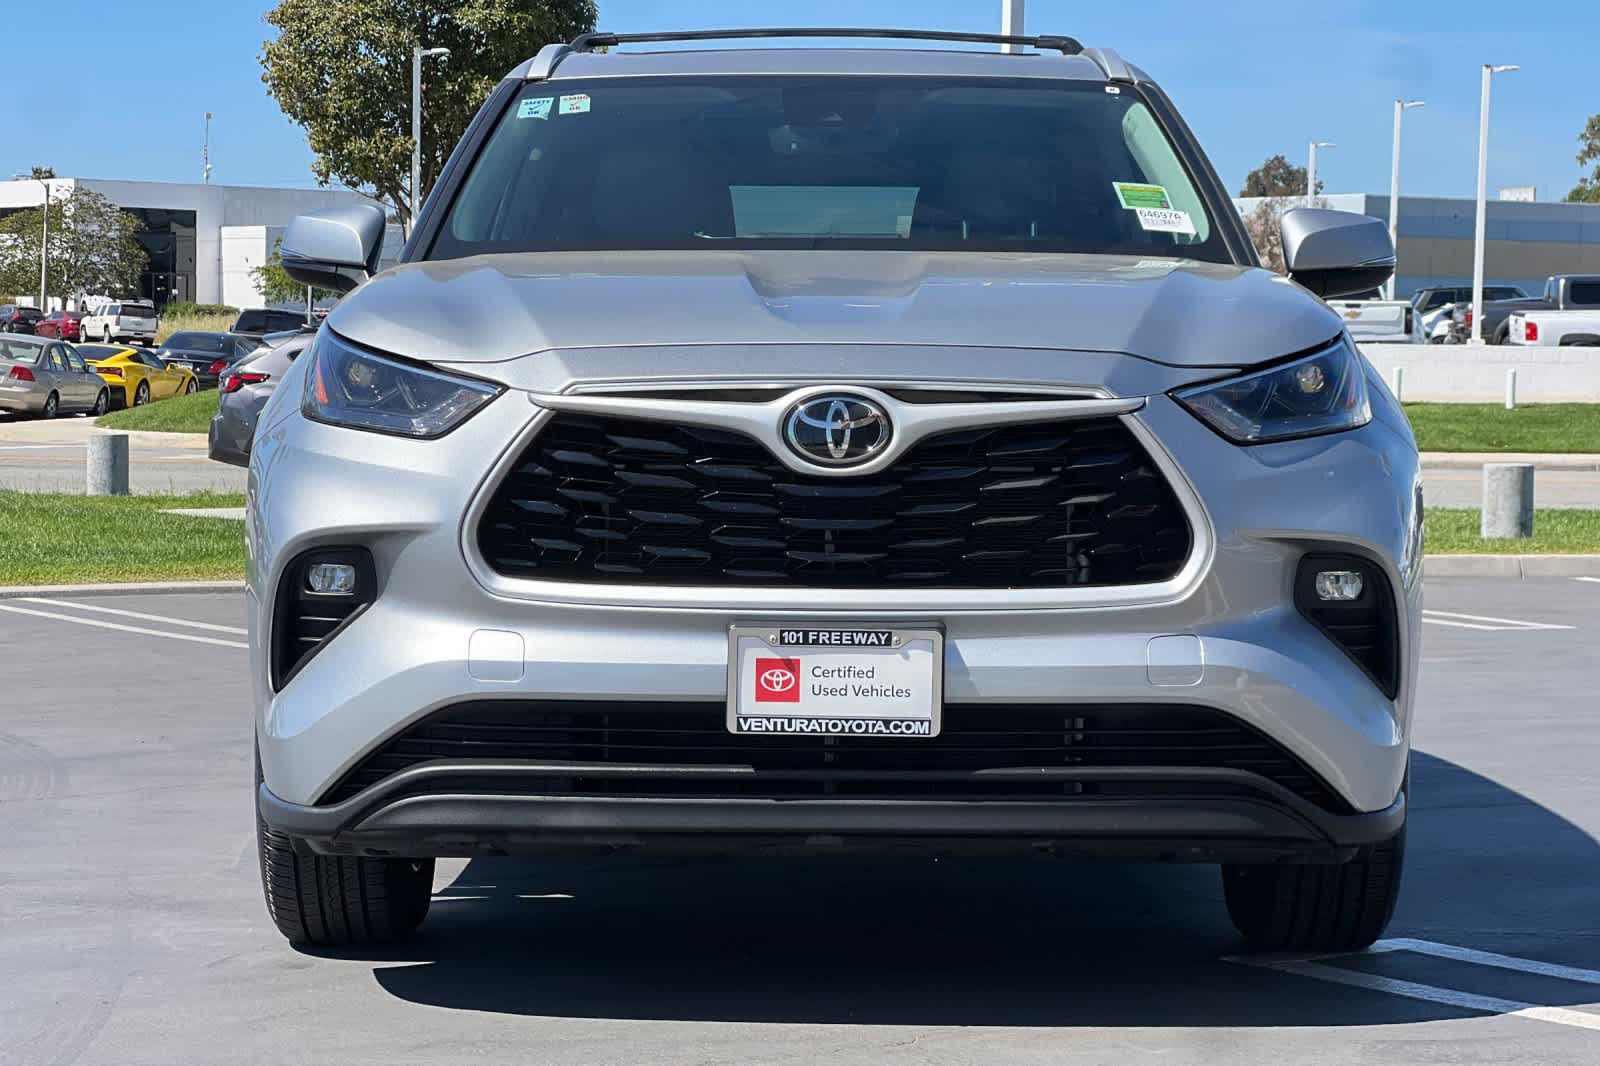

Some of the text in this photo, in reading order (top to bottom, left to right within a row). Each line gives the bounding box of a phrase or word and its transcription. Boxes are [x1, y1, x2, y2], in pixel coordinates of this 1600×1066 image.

[782, 631, 889, 645] 101 FREEWAY
[811, 666, 875, 679] Certified
[811, 684, 911, 698] Used Vehicles
[738, 717, 930, 734] VENTURATOYOTA.COM
